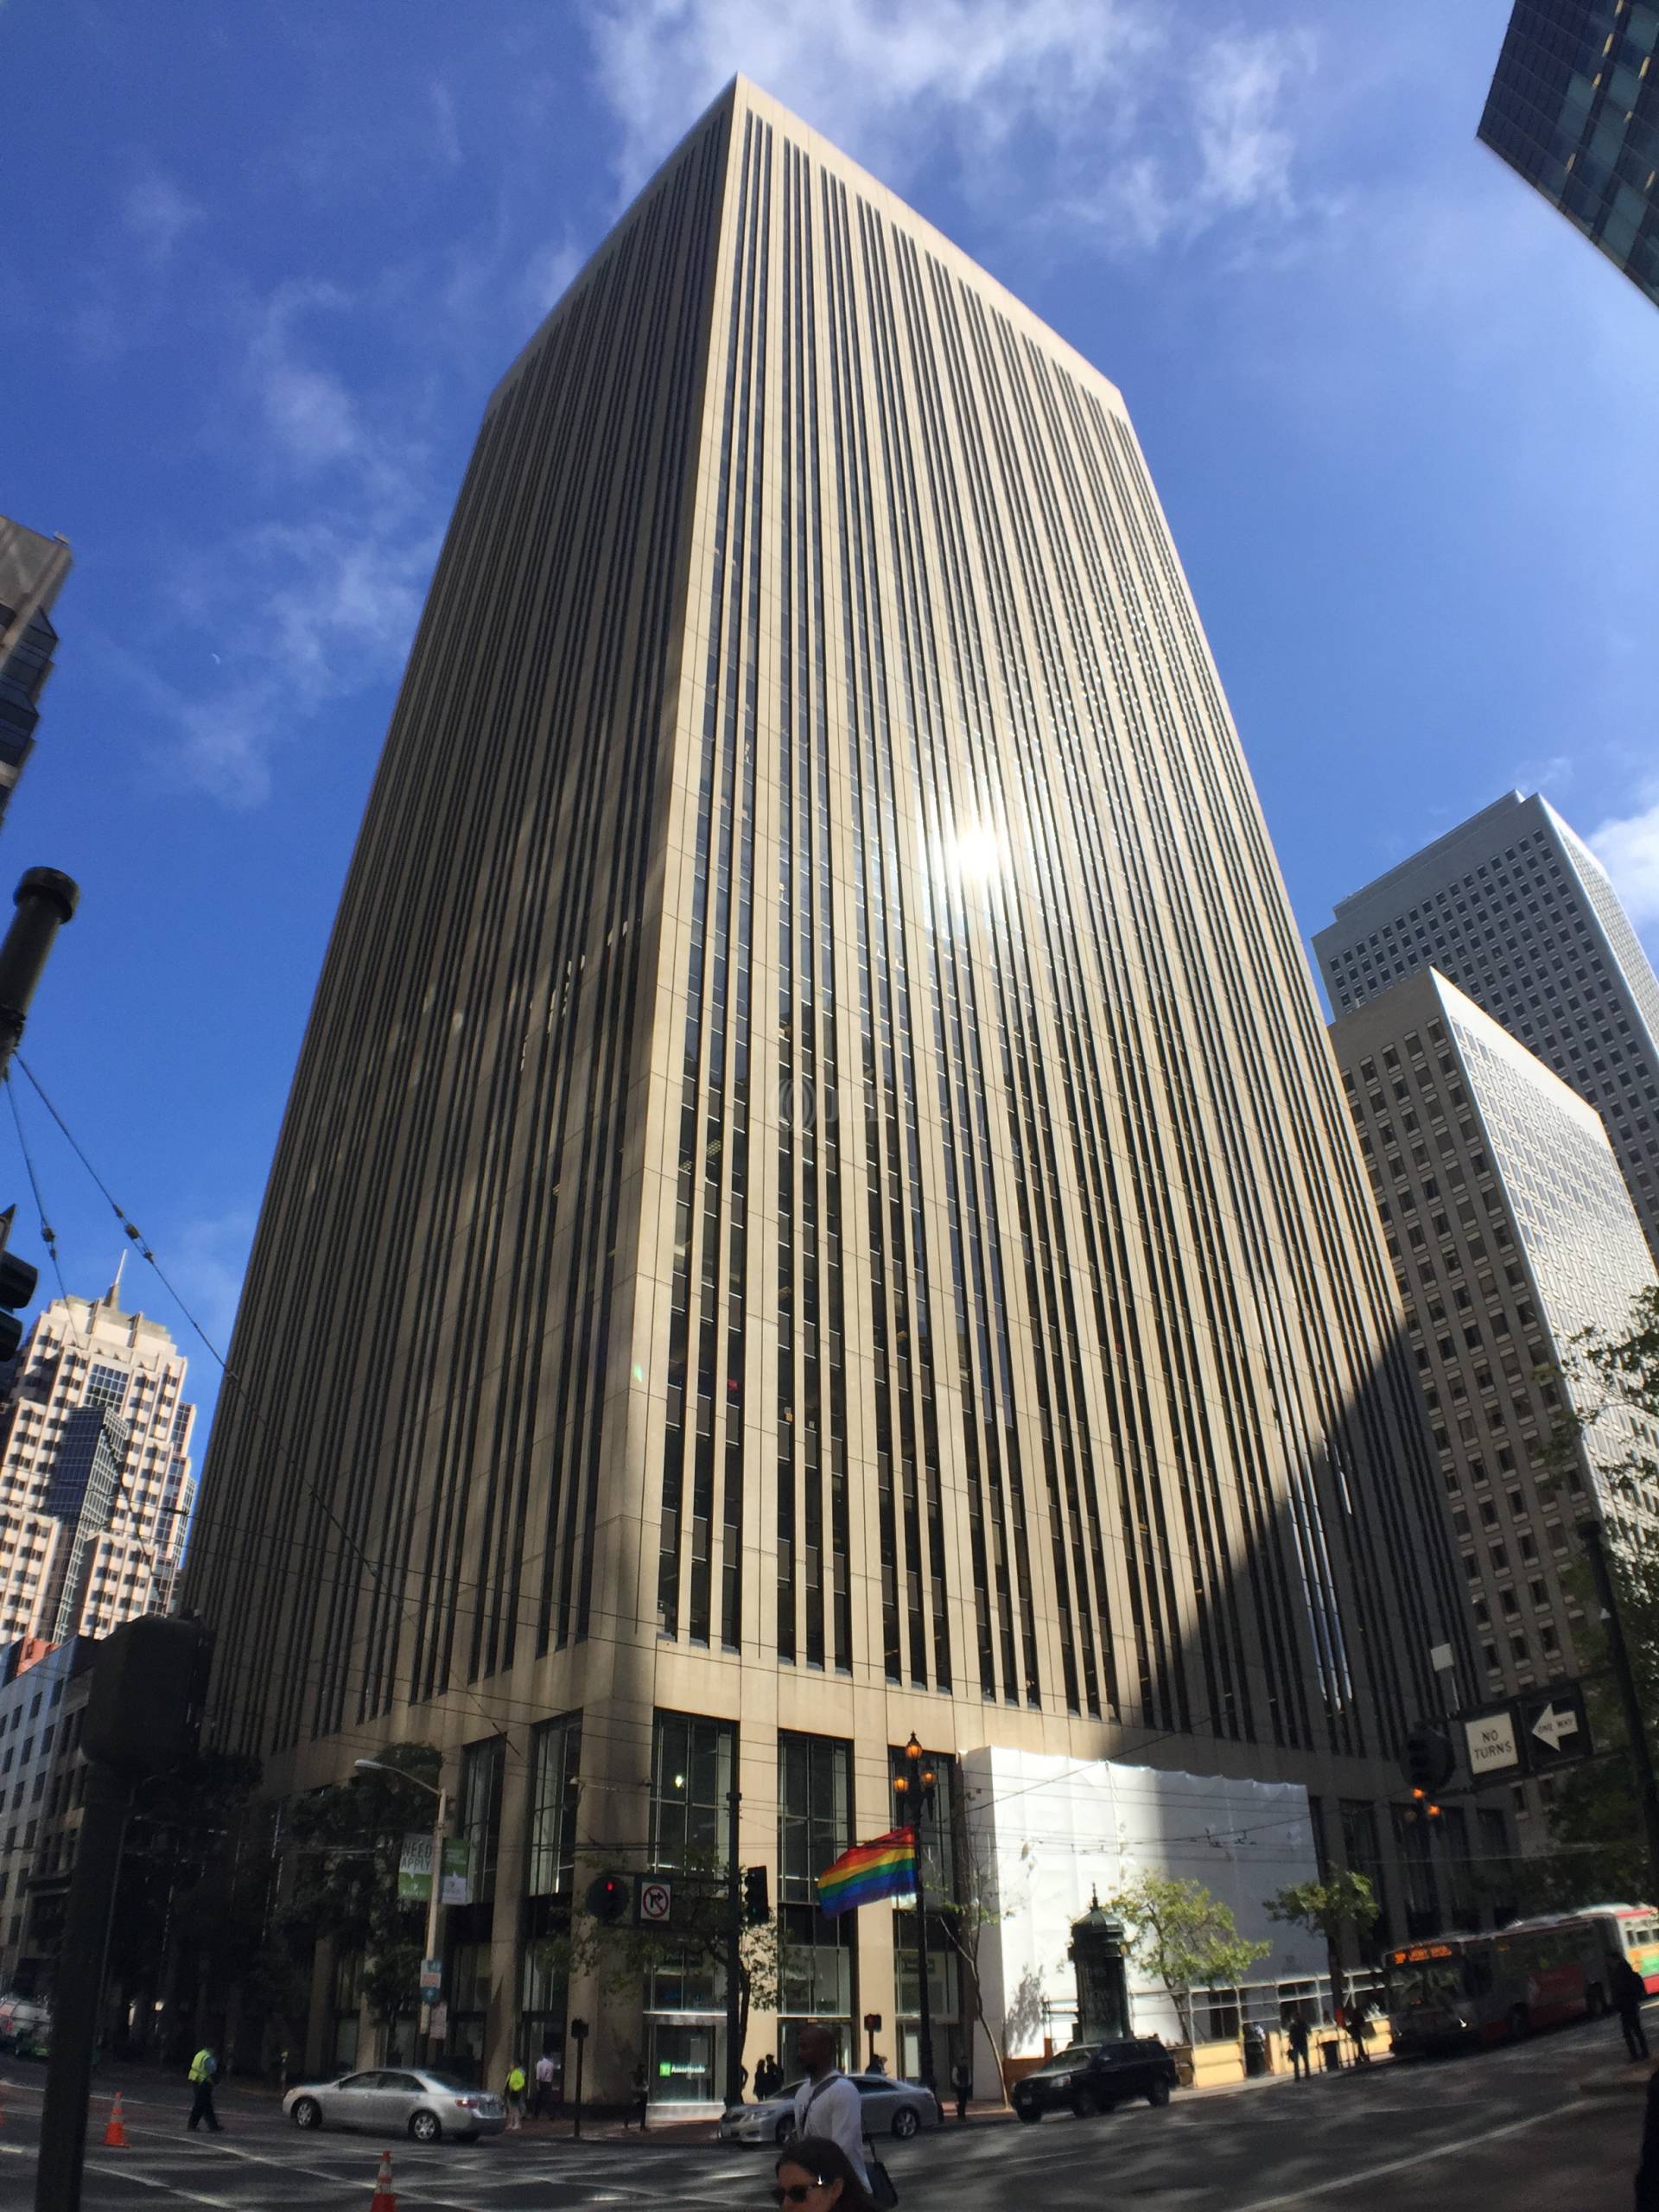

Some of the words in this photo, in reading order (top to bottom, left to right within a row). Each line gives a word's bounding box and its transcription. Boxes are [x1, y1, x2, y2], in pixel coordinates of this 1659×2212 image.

[1481, 1729, 1499, 1743] NO
[1474, 1740, 1512, 1760] TURNS
[400, 1856, 431, 1872] APPLY
